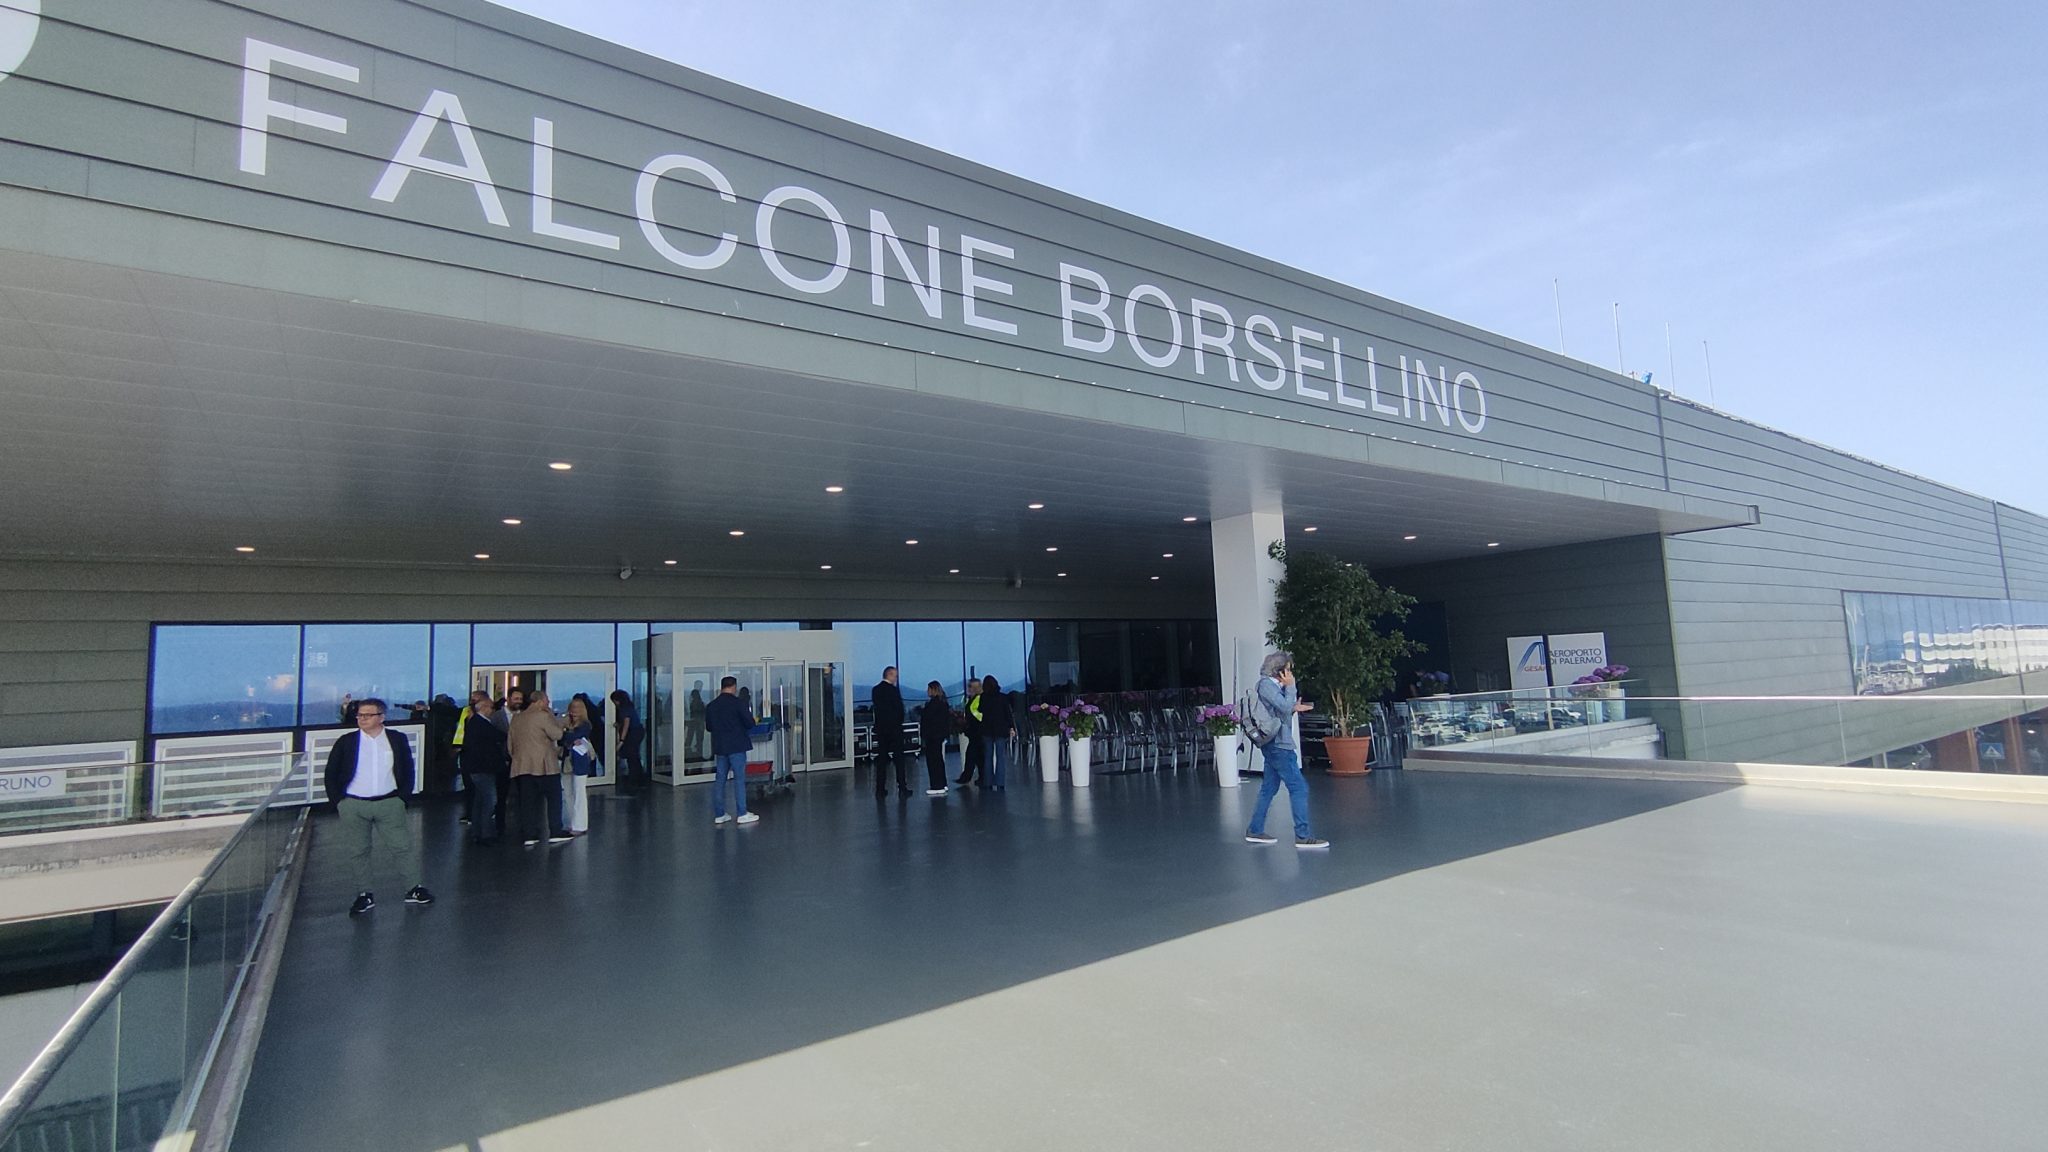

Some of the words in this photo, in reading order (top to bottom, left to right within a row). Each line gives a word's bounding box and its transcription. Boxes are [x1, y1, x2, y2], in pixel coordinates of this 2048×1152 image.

[239, 37, 1018, 336] FALCONE
[1059, 262, 1487, 434] BORSELLINO
[1549, 648, 1602, 658] AEROPORTO
[1560, 656, 1602, 665] PALERMO
